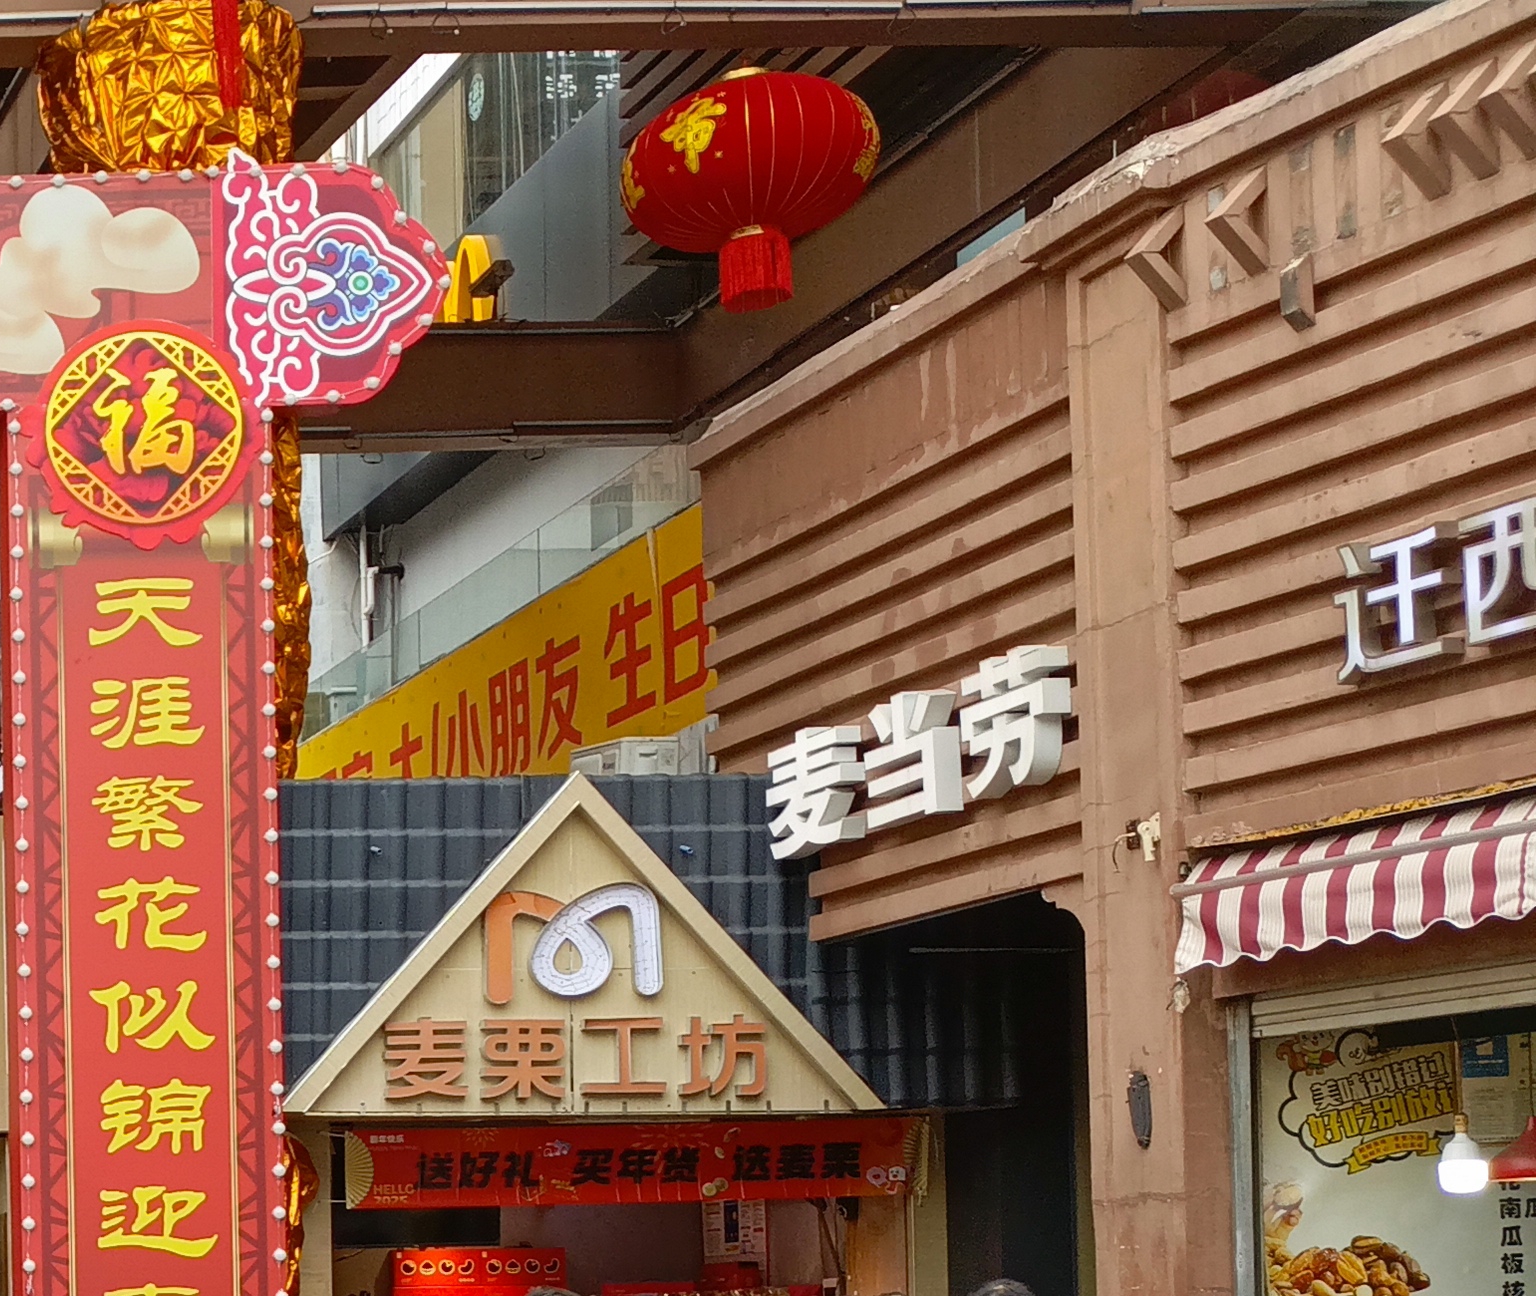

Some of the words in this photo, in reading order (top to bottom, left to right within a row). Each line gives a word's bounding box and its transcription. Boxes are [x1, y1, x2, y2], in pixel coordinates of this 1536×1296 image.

[93, 365, 197, 477] 福
[765, 644, 1071, 862] 麦当劳
[382, 1013, 768, 1102] 麦栗工坊
[1310, 1051, 1450, 1112] 美味别错过
[416, 1150, 542, 1191] 送好礼
[571, 1146, 702, 1185] 买年货
[731, 1140, 862, 1182] 送麦栗
